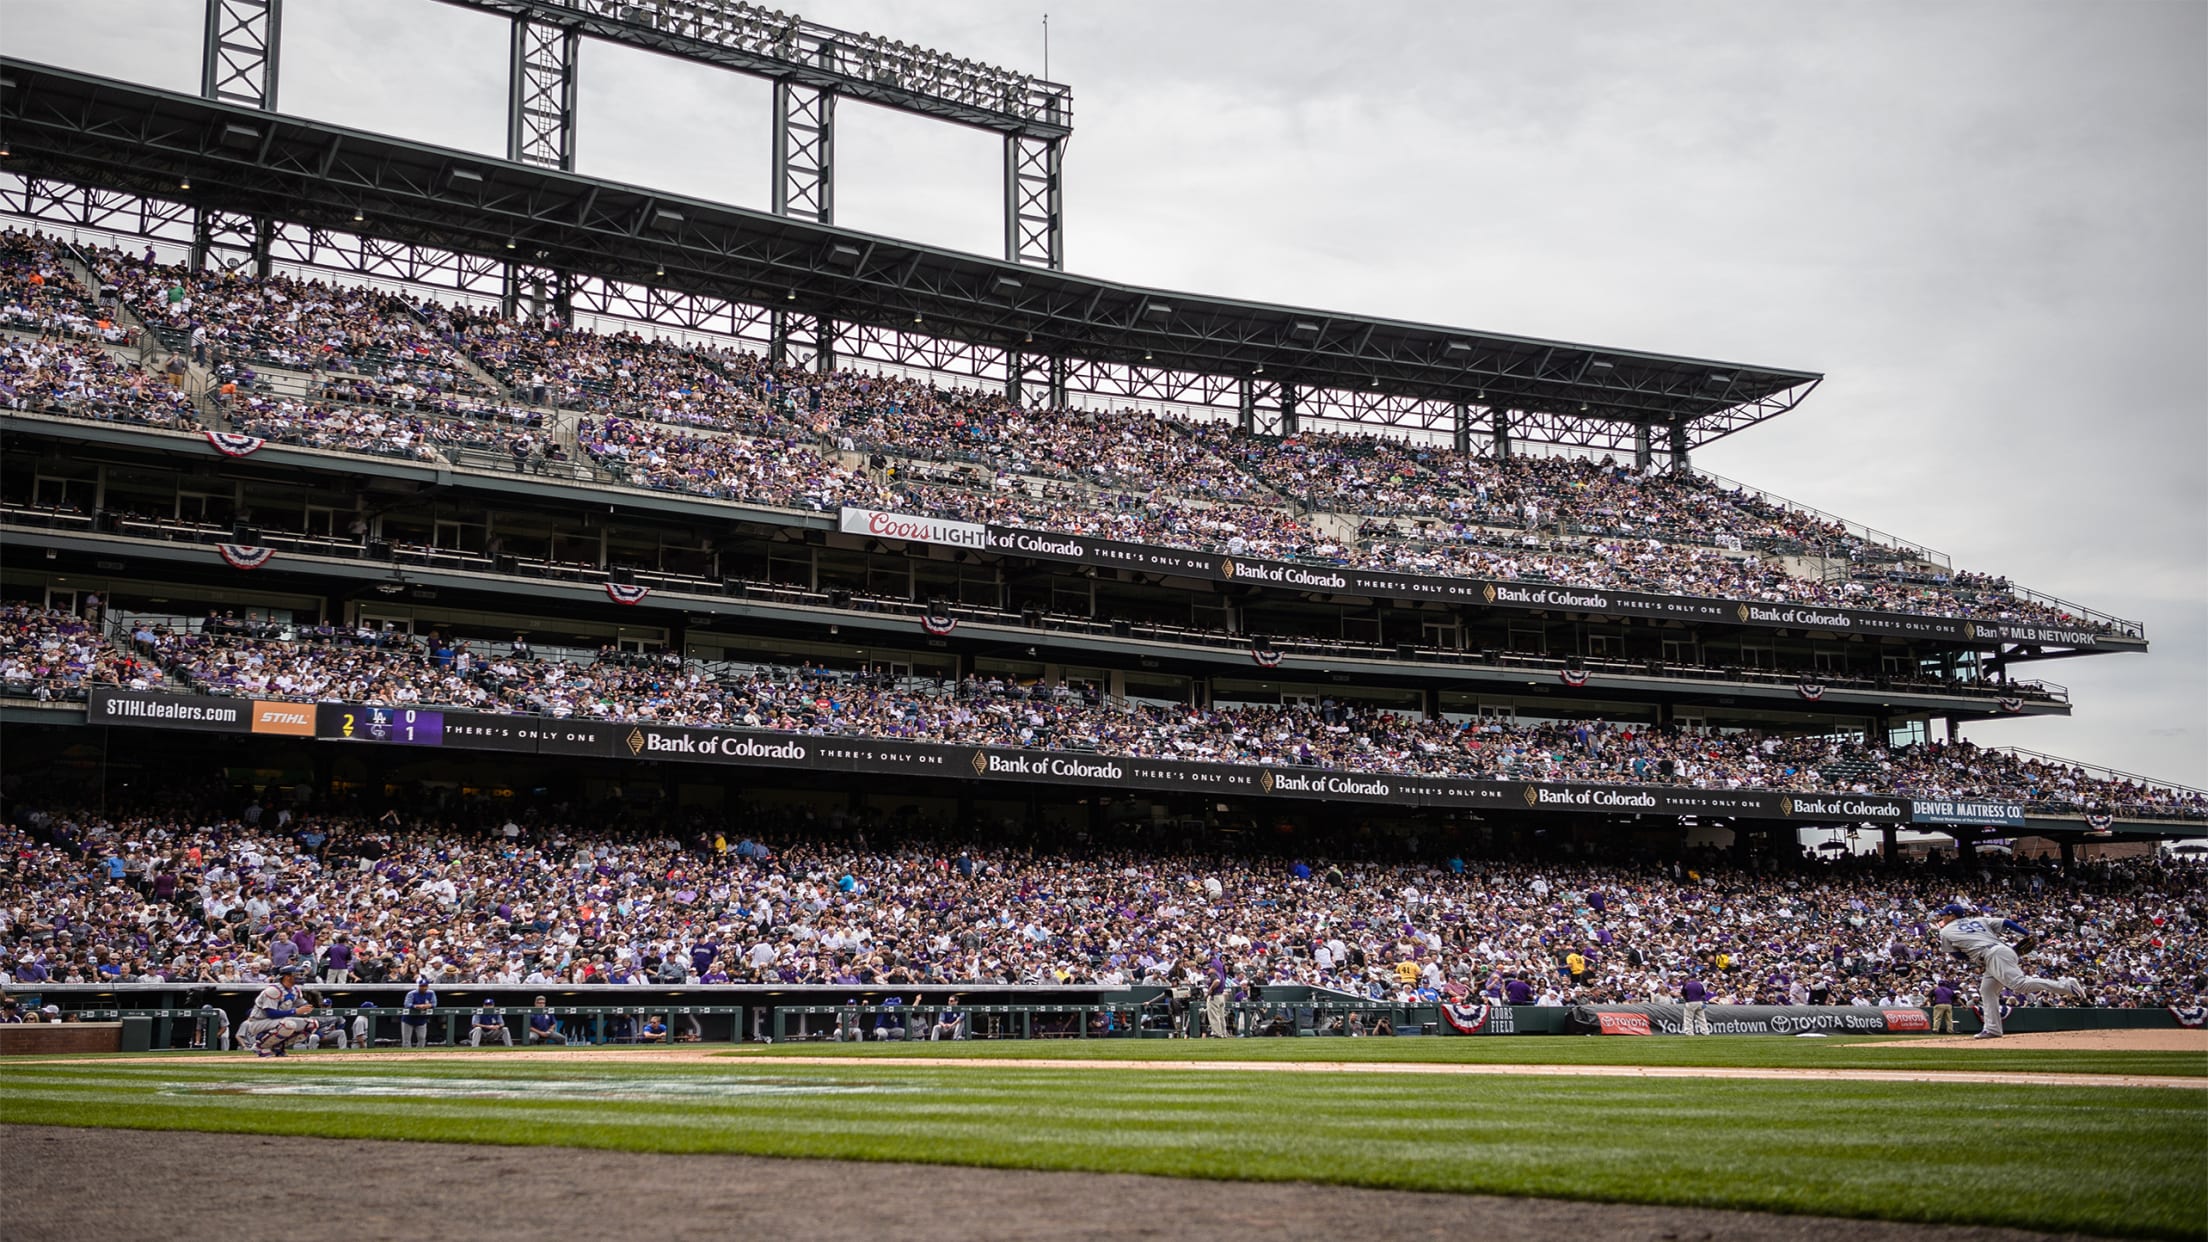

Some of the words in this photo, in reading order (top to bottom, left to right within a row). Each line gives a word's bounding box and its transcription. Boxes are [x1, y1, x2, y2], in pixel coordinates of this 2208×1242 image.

[869, 512, 931, 540] Coors
[933, 527, 984, 547] LIGHT
[1000, 533, 1015, 548] of
[1017, 535, 1084, 556] Colorado
[1094, 548, 1144, 561] THERE'S
[1151, 556, 1181, 566] ONLY
[1187, 561, 1210, 570] ONE
[1236, 562, 1268, 580] Bank
[1270, 567, 1284, 581] of
[1285, 568, 1346, 588] Colorado
[1356, 580, 1406, 590] THERE'S
[1413, 584, 1442, 592] ONLY
[1449, 587, 1472, 595] ONE
[1497, 587, 1530, 602] Bank
[1532, 590, 1546, 603] of
[1548, 591, 1607, 608] Colorado
[1616, 600, 1662, 610] THERE'S
[1668, 604, 1695, 612] ONLY
[1701, 606, 1722, 614] ONE
[1750, 608, 1781, 622] Bank
[1782, 610, 1796, 623] of
[1797, 611, 1850, 626] Colorado
[1858, 619, 1900, 628] THERE'S
[1906, 622, 1930, 631] ONLY
[1936, 625, 1955, 633] ONE
[2011, 627, 2036, 640] MLB
[2039, 630, 2096, 644] NETWORK
[106, 698, 236, 722] STIHLdealers.com
[372, 708, 386, 724] LA
[406, 710, 416, 724] 0
[260, 712, 308, 725] STIHL
[342, 714, 354, 730] 2
[406, 726, 414, 740] 1
[446, 725, 509, 737] THERE'S
[518, 730, 558, 740] ONLY
[567, 733, 596, 742] ONE
[647, 733, 696, 752] Bank
[698, 736, 719, 754] of
[722, 737, 806, 760] Colorado
[820, 750, 872, 760] THERE'S
[880, 752, 912, 762] ONLY
[920, 756, 943, 764] ONE
[989, 756, 1029, 773] Bank
[1032, 758, 1049, 775] of
[1051, 758, 1122, 780] Colorado
[1134, 770, 1184, 780] THERE'S
[1192, 773, 1222, 782] ONLY
[1228, 776, 1252, 784] ONE
[1275, 774, 1310, 791] Bank
[1312, 777, 1327, 792] of
[1328, 778, 1390, 796] Colorado
[1400, 786, 1443, 796] THERE'S
[1482, 790, 1502, 798] ONE
[1539, 788, 1576, 804] Bank
[1576, 790, 1592, 805] of
[1592, 791, 1656, 808] Colorado
[1666, 798, 1707, 806] THERE'S
[1794, 800, 1826, 814] Bank
[1828, 801, 1842, 815] of
[1843, 802, 1900, 817] Colorado
[1914, 802, 1954, 815] DENVER
[1957, 804, 2004, 818] MATTRESS
[1958, 920, 1986, 932] 99
[1490, 1007, 1513, 1020] COORS
[1491, 1021, 1514, 1032] FIELD
[1658, 1020, 1684, 1033] You
[1791, 1016, 1844, 1030] TOYOTA
[1846, 1015, 1883, 1028] Stores
